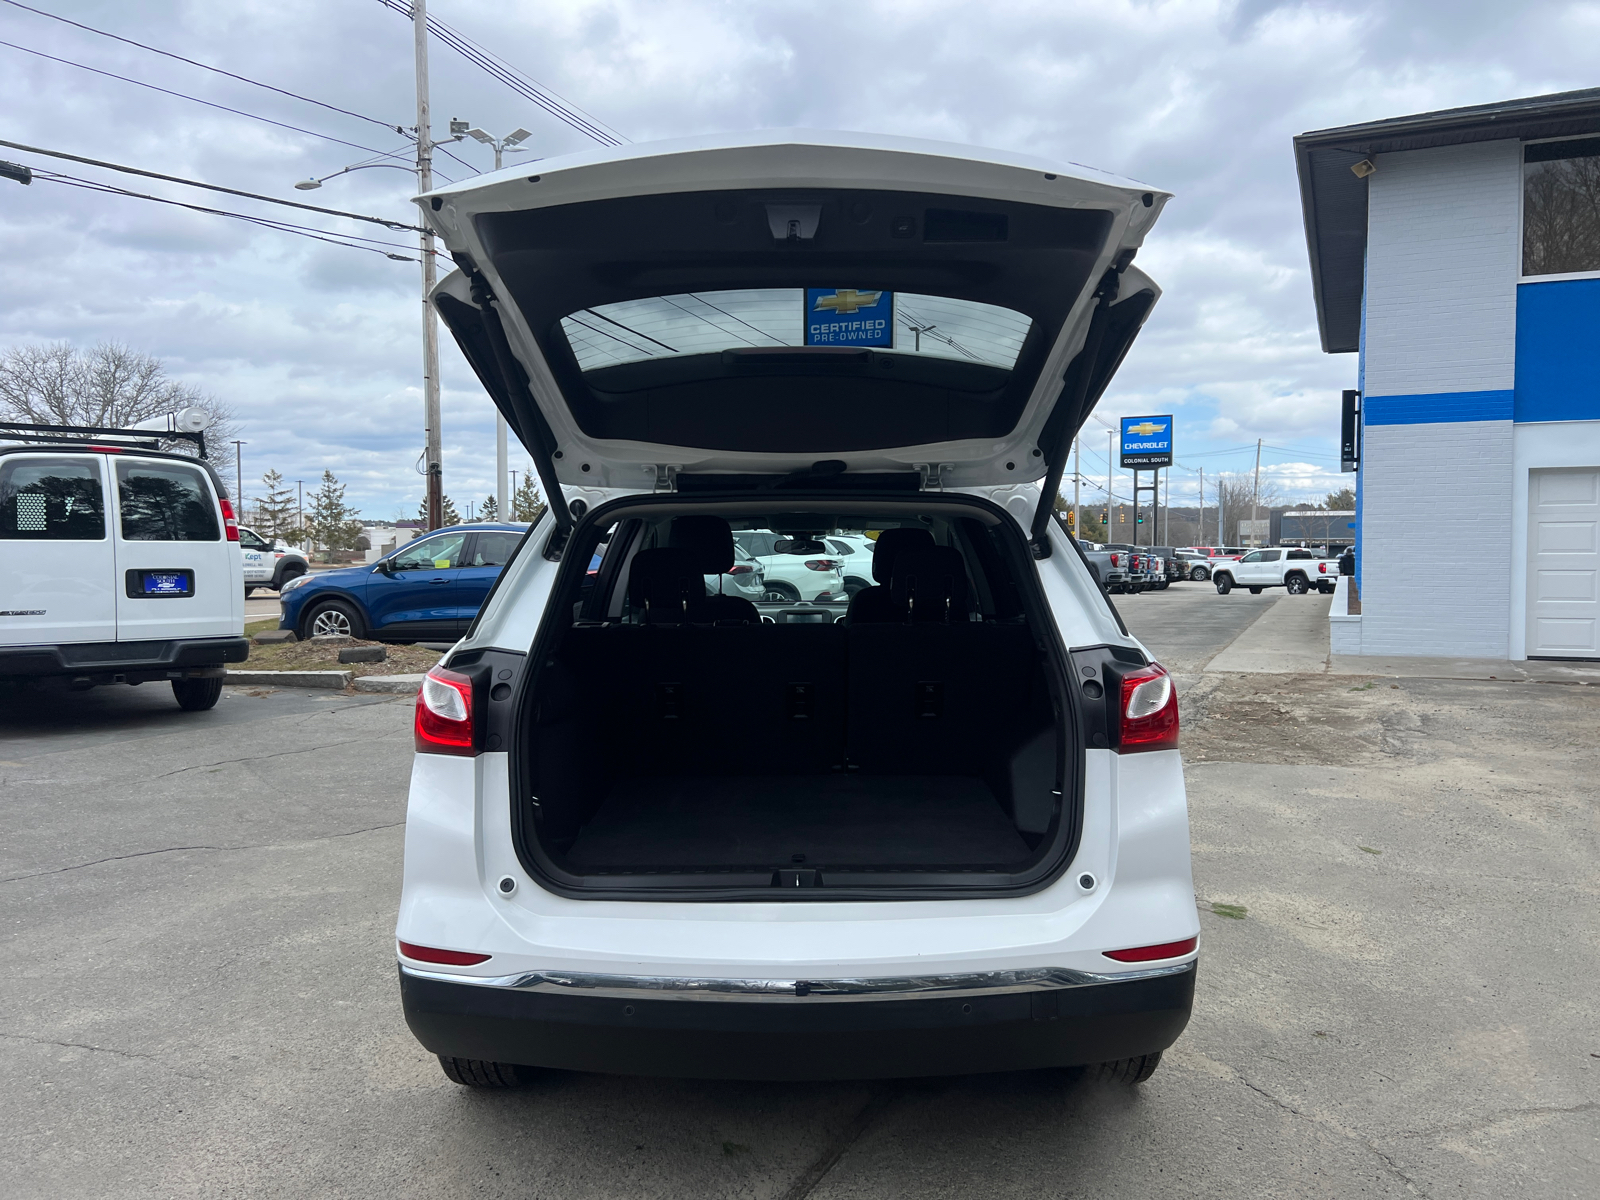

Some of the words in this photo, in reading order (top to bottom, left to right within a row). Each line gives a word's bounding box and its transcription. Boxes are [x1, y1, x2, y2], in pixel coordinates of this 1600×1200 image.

[810, 319, 886, 334] CERTIFIED
[814, 329, 882, 343] PRE-OWNED
[1124, 441, 1169, 450] CHEVROLET
[245, 553, 262, 561] Kept
